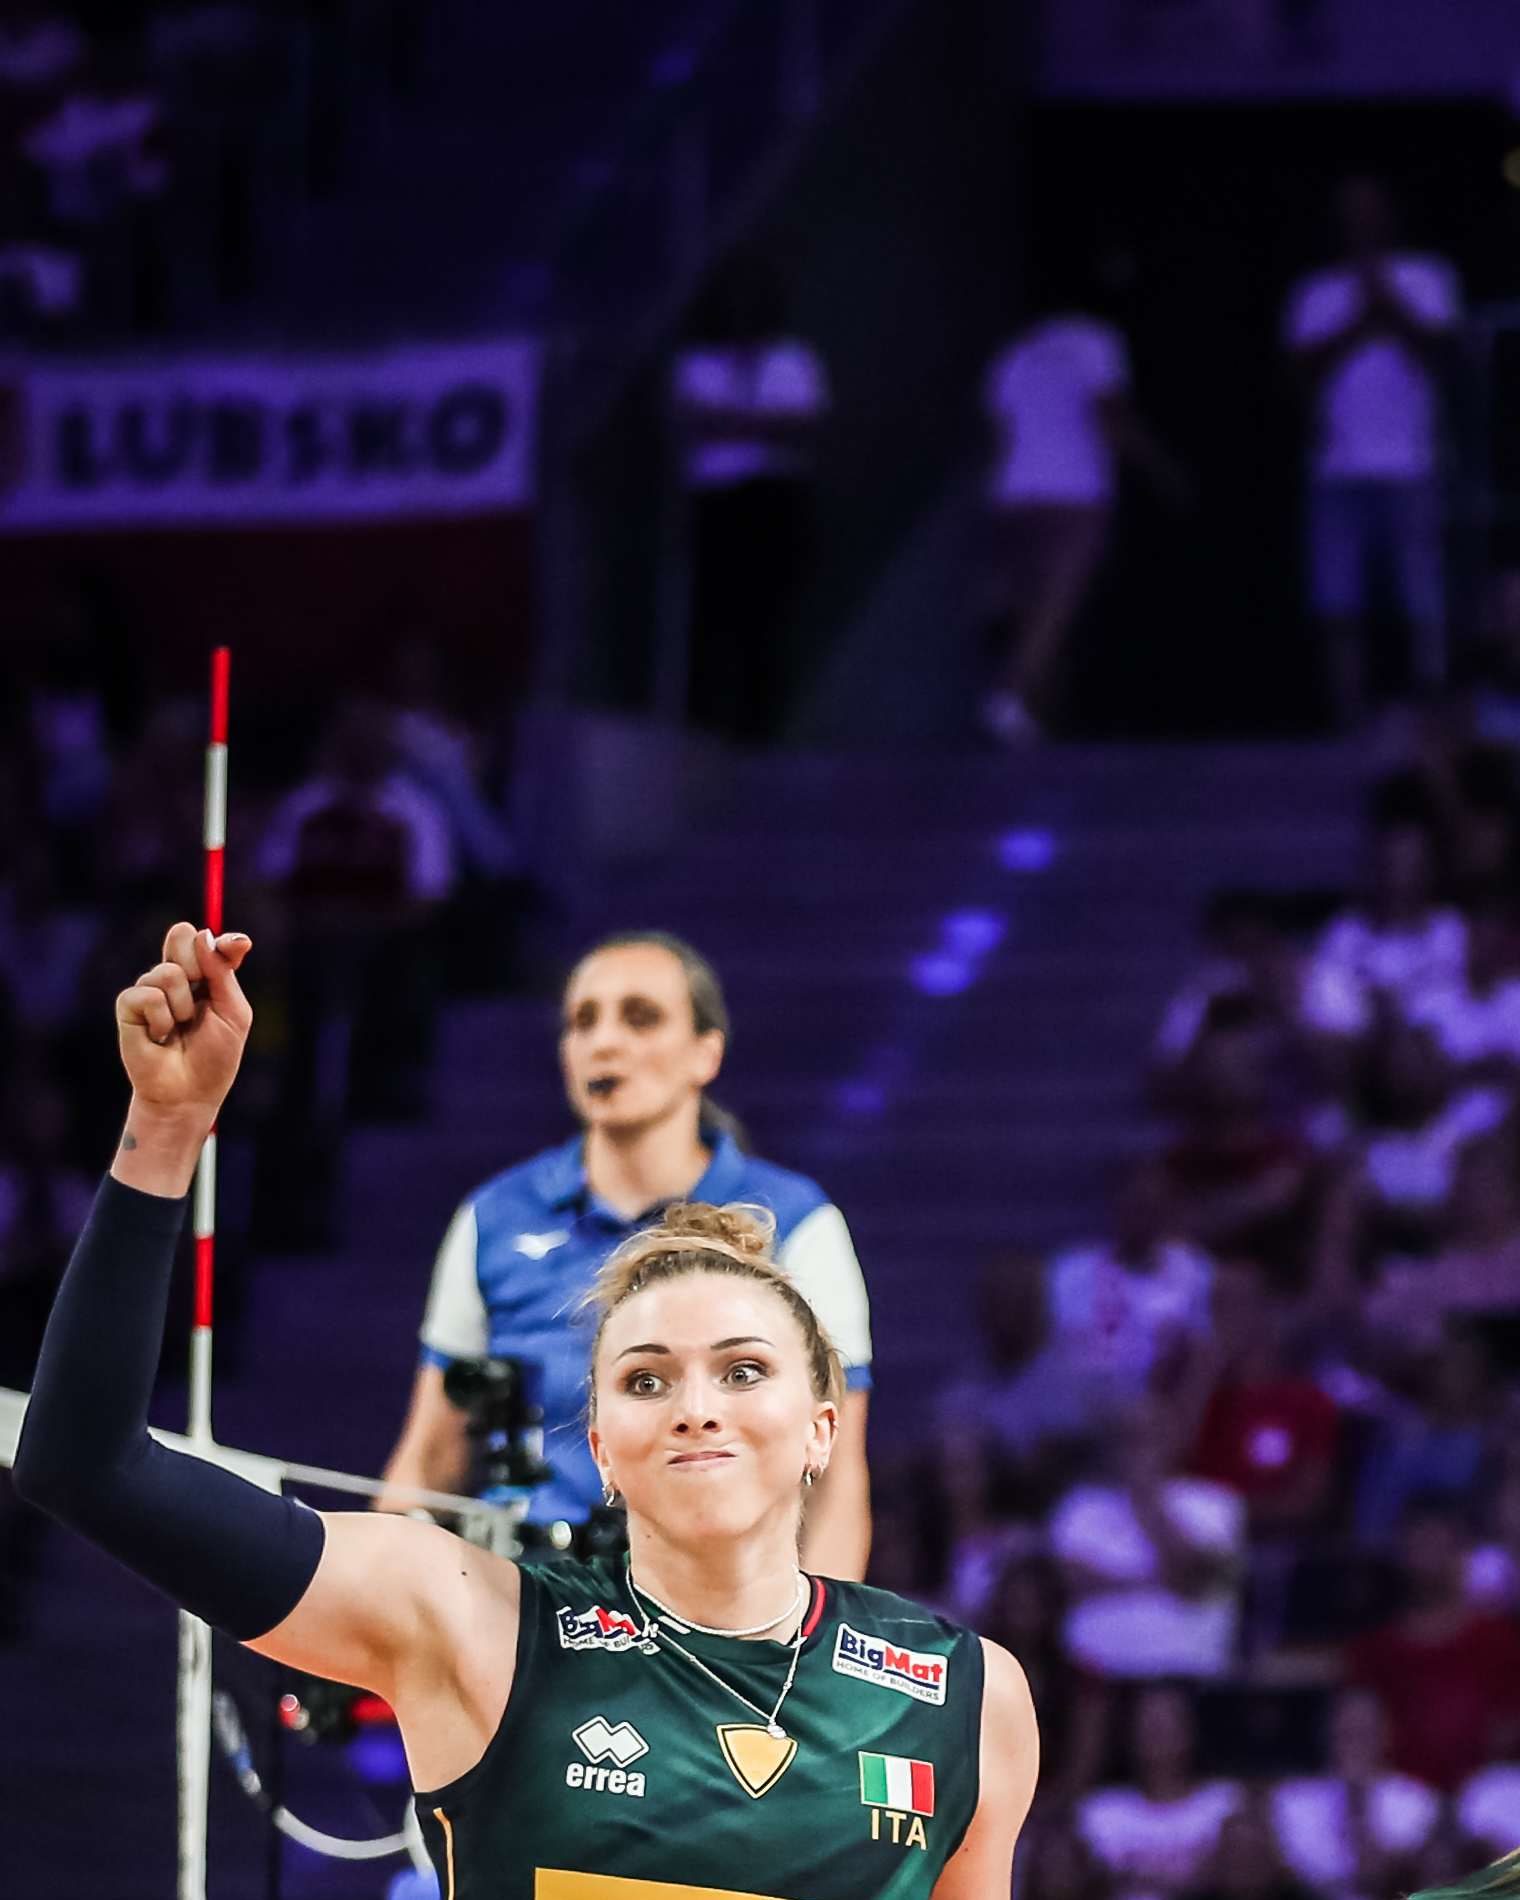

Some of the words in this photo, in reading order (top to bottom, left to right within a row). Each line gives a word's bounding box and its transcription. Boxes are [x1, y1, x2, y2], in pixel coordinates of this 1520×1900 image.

[840, 1626, 943, 1683] BigMat
[566, 1762, 645, 1797] errea
[870, 1808, 927, 1850] ITA
